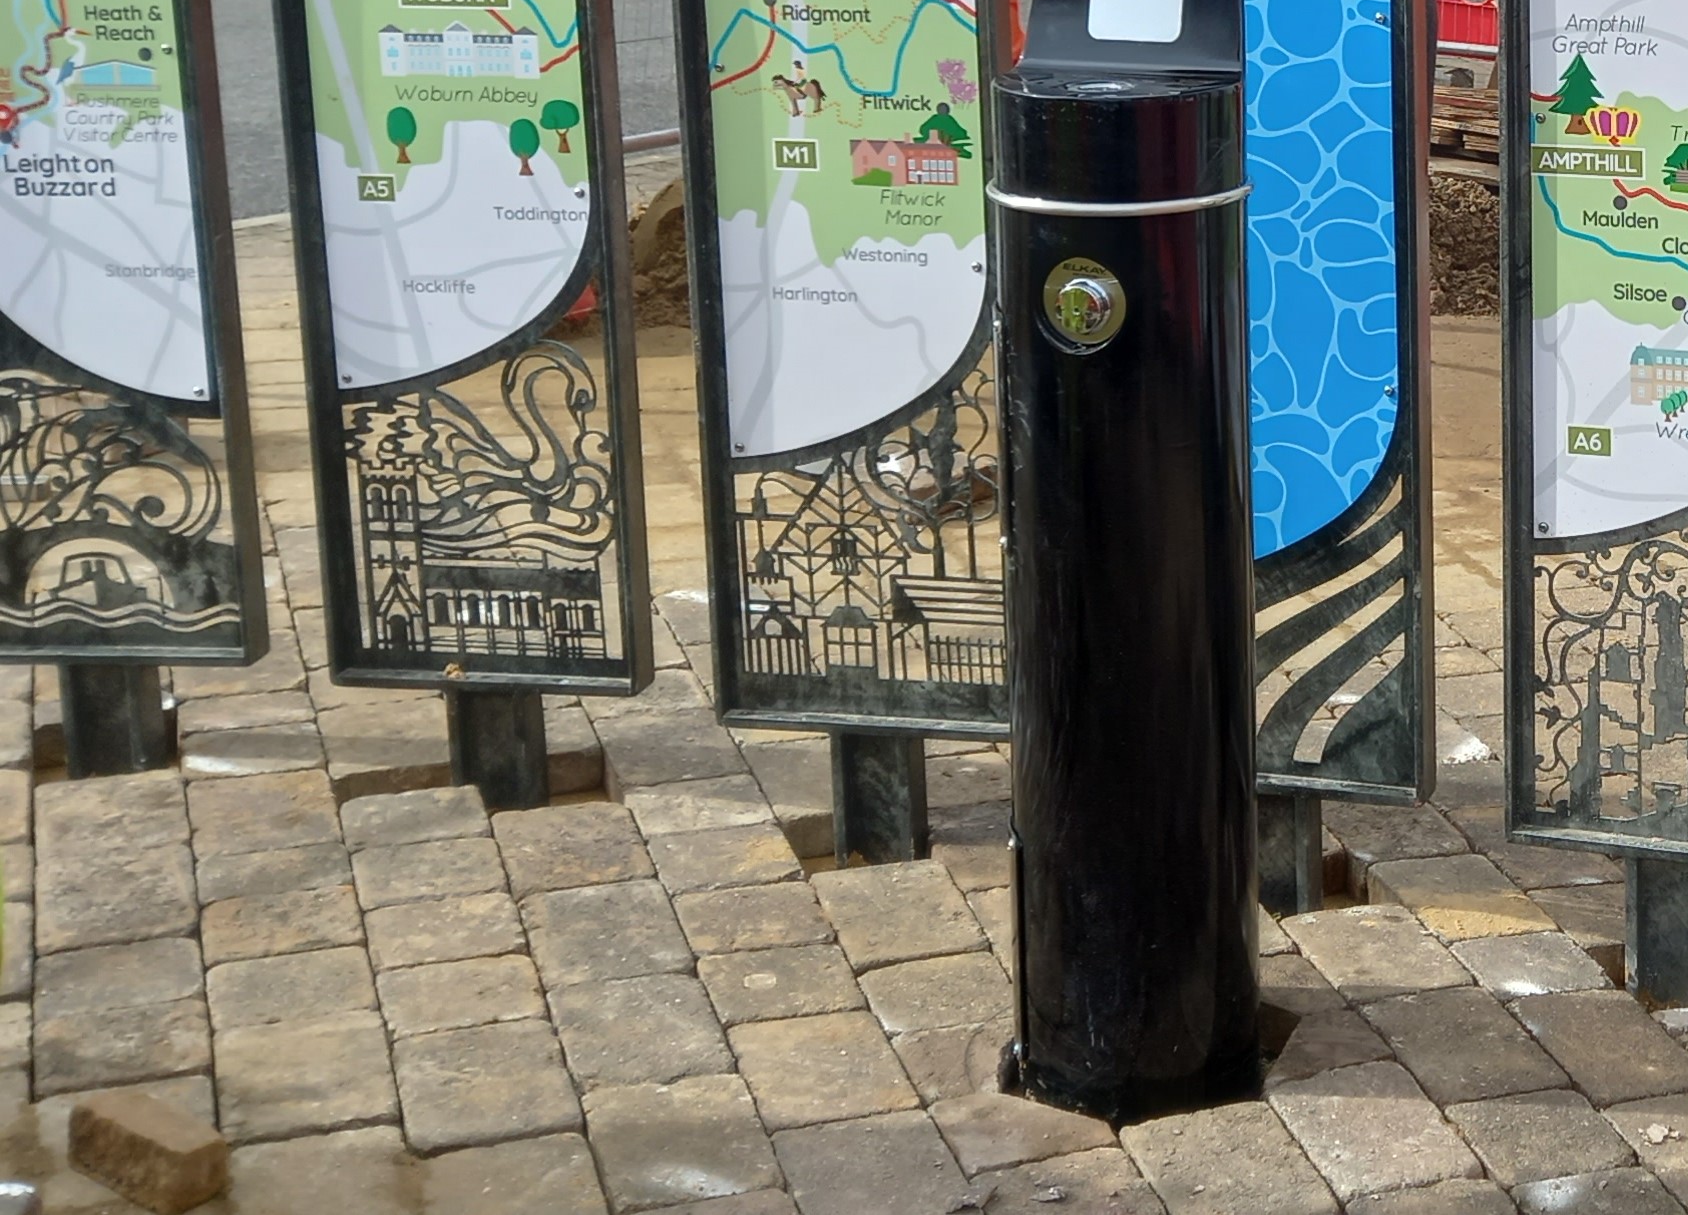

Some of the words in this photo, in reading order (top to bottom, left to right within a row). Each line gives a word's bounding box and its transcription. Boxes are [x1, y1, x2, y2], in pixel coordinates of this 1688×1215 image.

[84, 6, 142, 22] Heath
[148, 6, 162, 22] &
[782, 4, 870, 24] Ridgmont
[96, 26, 155, 41] Reach
[1565, 14, 1645, 36] Ampthill
[1552, 36, 1607, 54] Great
[1614, 38, 1658, 56] Park
[395, 85, 475, 103] Woburn
[479, 86, 537, 107] Abbey
[862, 95, 931, 112] Flitwick
[783, 147, 810, 164] M1
[1539, 151, 1637, 173] AMPTHILL
[4, 154, 114, 178] Leighton
[15, 178, 116, 196] Buzzard
[363, 180, 389, 198] A5
[880, 190, 945, 207] Flitwick
[493, 206, 587, 224] Toddington
[885, 211, 942, 226] Manor
[1583, 211, 1658, 229] Maulden
[843, 248, 928, 266] Westoning
[1063, 263, 1107, 274] ELKAY
[403, 278, 475, 295] Hockliffe
[773, 287, 857, 304] Harlington
[1613, 284, 1667, 303] Silsoe
[1574, 432, 1602, 449] A6
